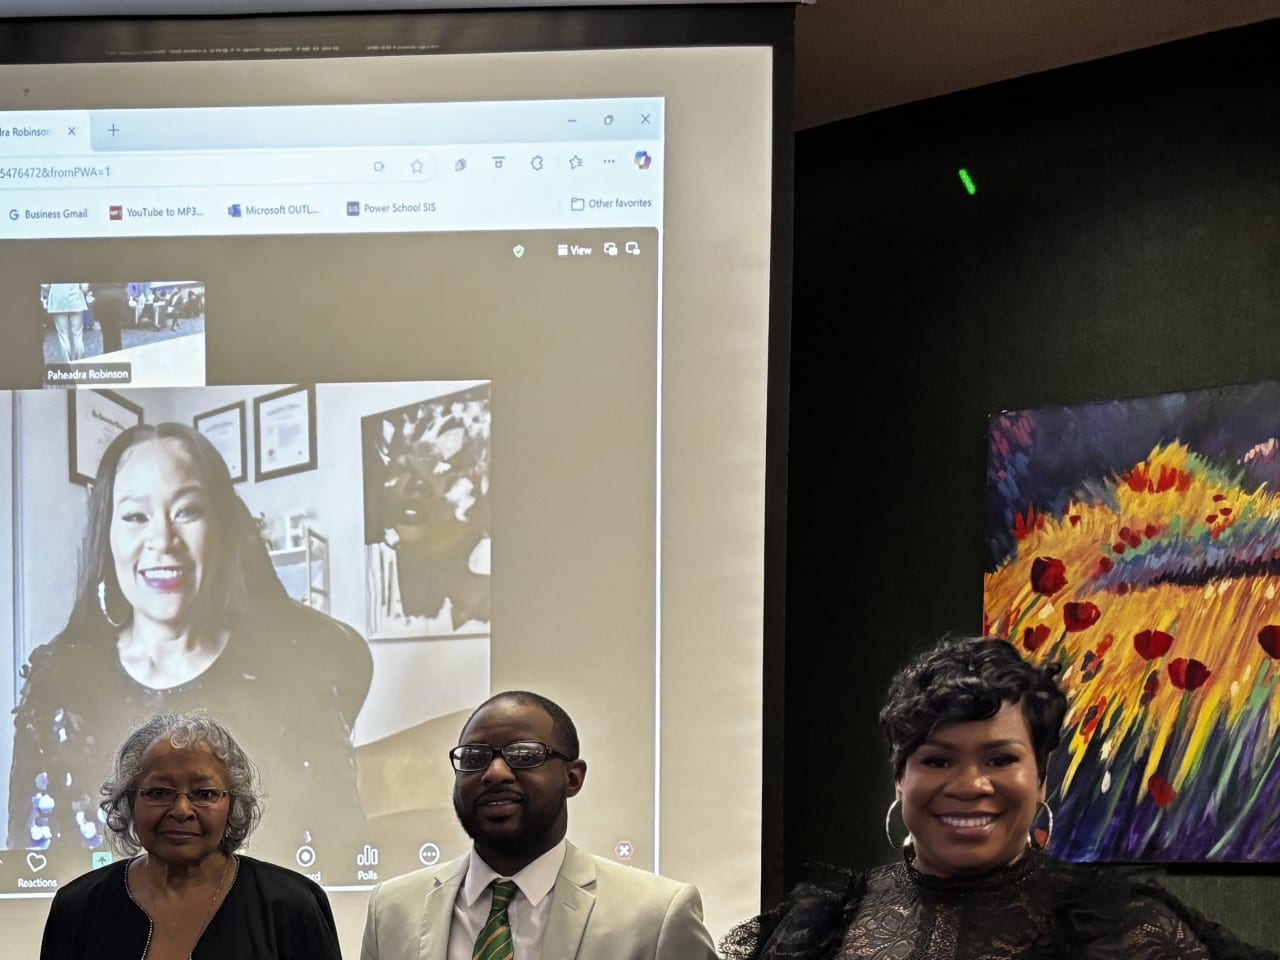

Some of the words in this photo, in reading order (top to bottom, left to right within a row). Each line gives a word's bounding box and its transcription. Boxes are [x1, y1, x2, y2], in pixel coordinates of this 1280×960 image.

[364, 203, 391, 213] Power
[391, 202, 421, 212] School
[422, 202, 437, 212] SIS
[588, 198, 613, 209] Other
[615, 197, 652, 208] favorites
[24, 209, 61, 220] Business
[63, 207, 88, 219] Gmail
[126, 206, 164, 217] YouTube
[166, 207, 175, 217] to
[245, 204, 286, 215] Microsoft
[570, 245, 592, 256] View
[47, 369, 87, 380] Paheadra
[88, 369, 129, 380] Robinson
[357, 870, 379, 880] Polls
[17, 878, 58, 888] Reactions
